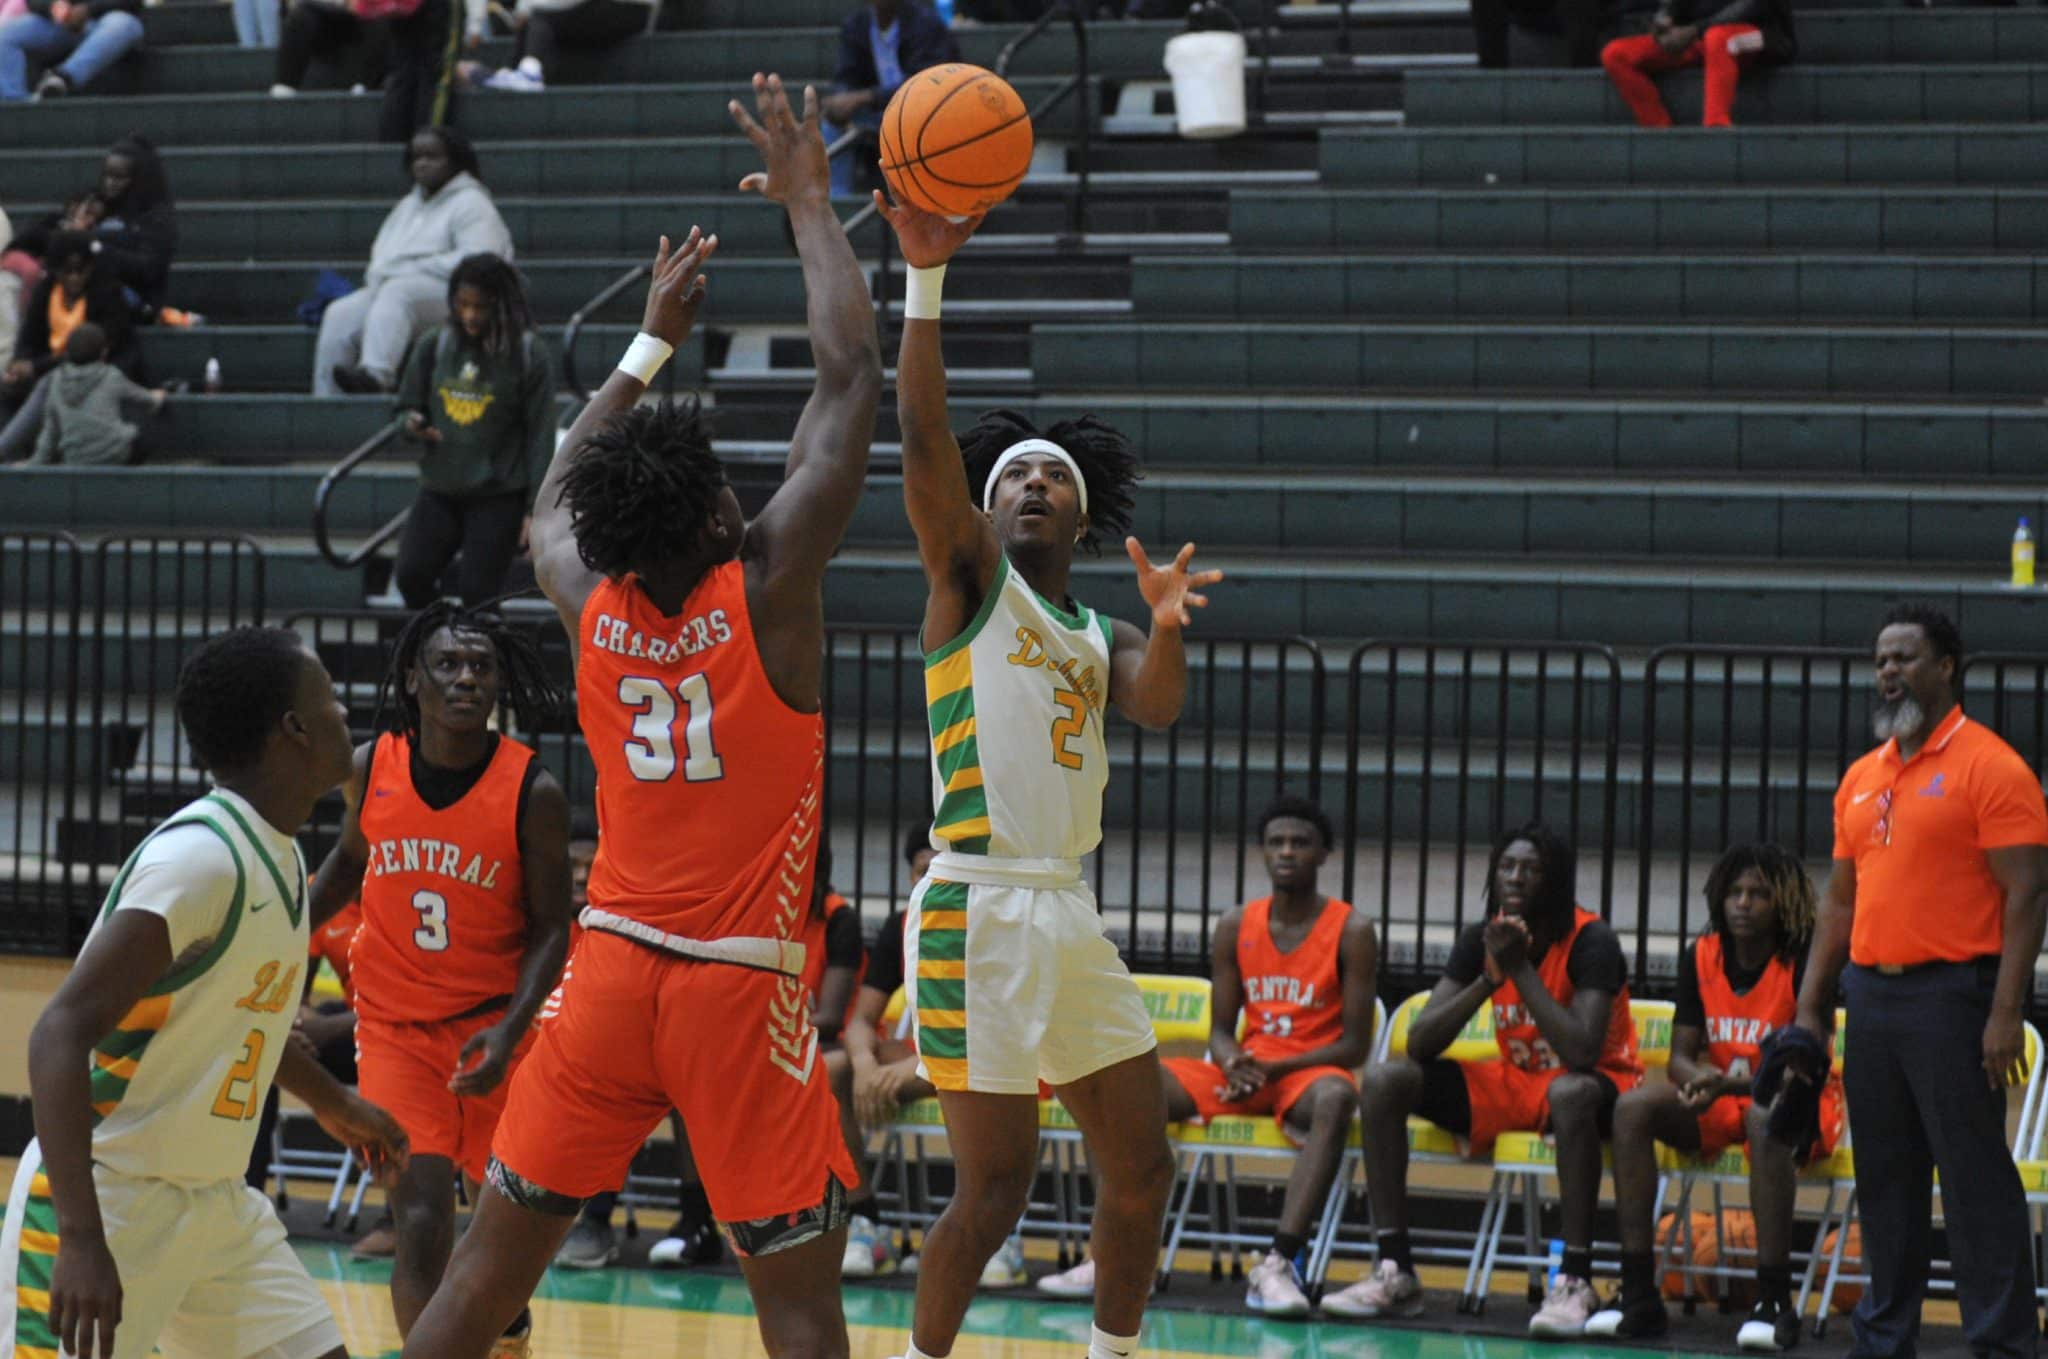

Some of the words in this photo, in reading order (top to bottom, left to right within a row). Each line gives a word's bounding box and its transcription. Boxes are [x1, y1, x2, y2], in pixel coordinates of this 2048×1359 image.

[618, 671, 725, 783] 31
[1052, 688, 1087, 771] 2
[369, 838, 502, 889] CENTRAL
[411, 888, 449, 952] 3
[1142, 991, 1206, 1022] BLIN
[1246, 975, 1326, 1009] ENTRA
[1705, 1016, 1772, 1045] ENTRA
